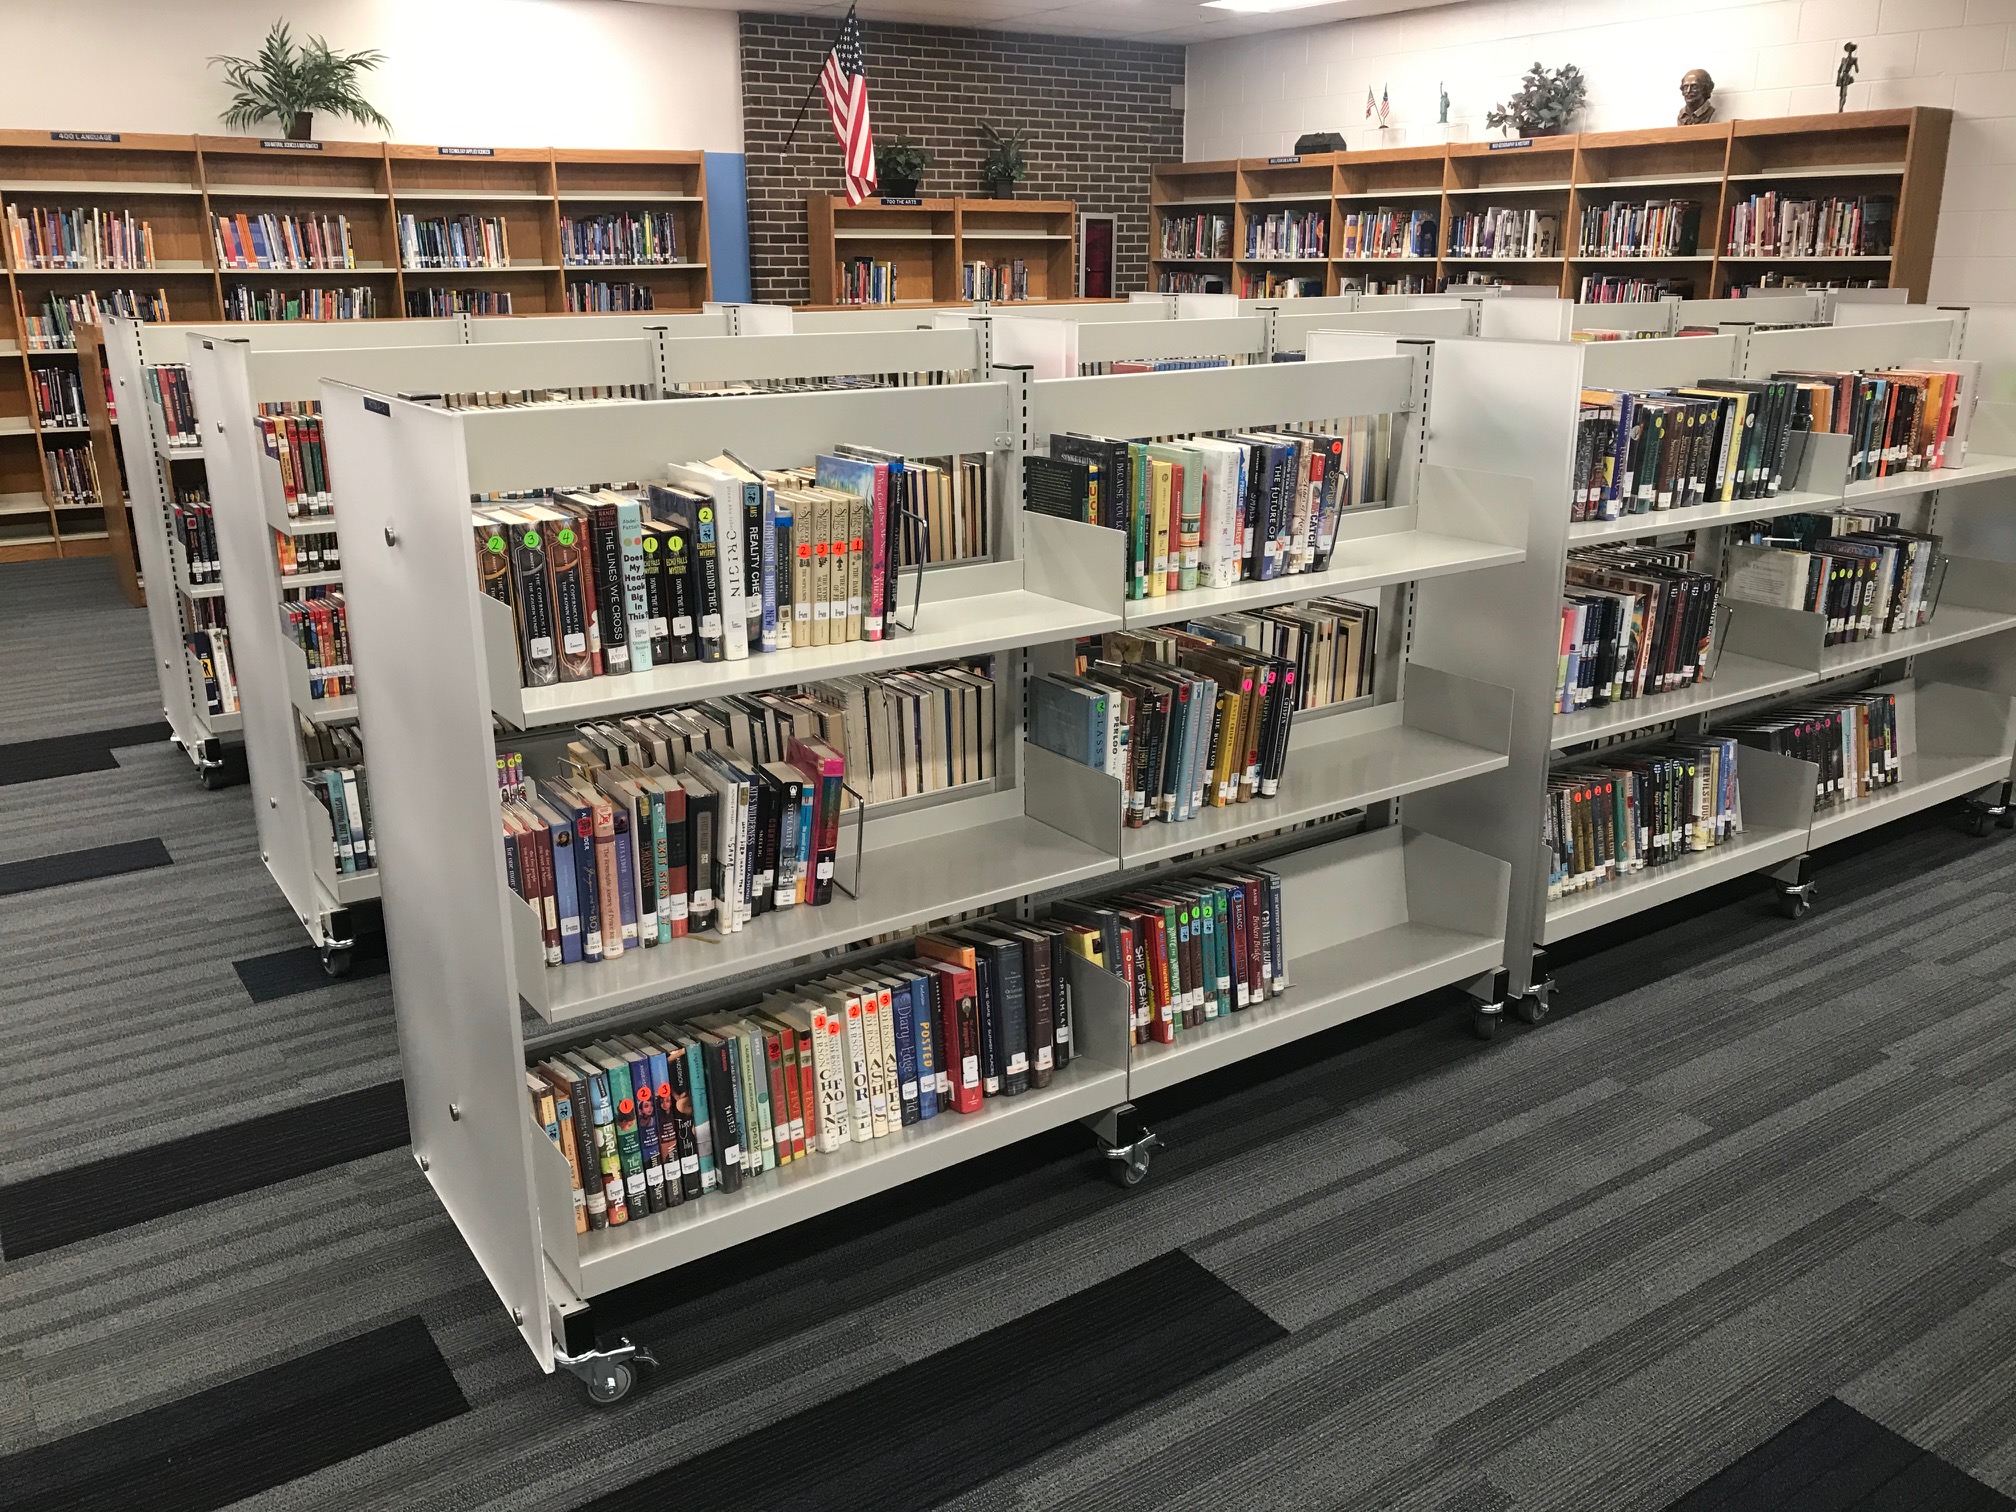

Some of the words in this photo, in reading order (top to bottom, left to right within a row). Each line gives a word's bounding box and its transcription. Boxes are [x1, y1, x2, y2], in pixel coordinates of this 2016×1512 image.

[1326, 470, 1338, 504] Sophie
[702, 511, 708, 520] 2
[1089, 486, 1097, 526] UCH
[1269, 487, 1280, 524] FUTURE
[528, 534, 534, 544] 3
[562, 532, 570, 543] 4
[605, 530, 614, 551] THE
[1235, 516, 1244, 545] FOREVE
[1268, 526, 1276, 540] OF
[1308, 512, 1318, 548] CATCH
[492, 538, 499, 550] 2
[750, 526, 760, 569] REALITY
[764, 520, 774, 562] CONFUSION
[800, 546, 806, 555] 2
[818, 544, 824, 554] 3
[836, 543, 842, 552] 4
[854, 540, 861, 550] 1
[606, 553, 618, 582] LINES
[624, 554, 642, 562] Does
[630, 564, 640, 572] My
[666, 558, 676, 566] ECHO
[676, 557, 687, 565] FALLS
[726, 530, 740, 598] ORIGIN
[625, 574, 646, 582] Head
[669, 566, 686, 574] MYSTERY
[706, 559, 716, 589] BEHIND
[765, 565, 774, 573] IS
[610, 585, 620, 603] WE
[626, 583, 646, 592] Look
[631, 594, 644, 602] Big
[765, 576, 775, 606] NOTHING
[709, 592, 717, 608] THE
[1710, 594, 1719, 624] DISASTER
[612, 606, 622, 640] CROSS
[628, 611, 648, 620] This?
[766, 610, 774, 626] NEW
[1270, 674, 1274, 682] 2
[1281, 698, 1289, 724] CRISPIN
[1211, 734, 1219, 767] BUTTON
[1702, 767, 1710, 796] DEVILS
[786, 803, 794, 826] STEVE
[1701, 806, 1709, 821] DUS
[748, 805, 757, 846] WILDERNESS
[785, 827, 794, 848] ALTEN
[657, 839, 667, 865] EXIT
[641, 846, 654, 887] CROSSOVER
[1205, 908, 1210, 916] 2
[1262, 931, 1270, 947] THE
[1135, 946, 1144, 971] SHIP
[1251, 940, 1260, 961] Bridge
[883, 995, 889, 1004] 3
[1138, 974, 1150, 1009] BREAK
[852, 1007, 857, 1016] 2
[831, 1024, 836, 1033] 2
[896, 1006, 911, 1039] Diary
[920, 1022, 932, 1067] POSTED
[899, 1046, 915, 1074] Edge
[662, 1085, 668, 1094] 3
[870, 1059, 886, 1123] ASHS
[600, 1097, 610, 1116] ME
[725, 1105, 736, 1134] TWISTED
[603, 1124, 616, 1158] EARL
[750, 1121, 760, 1152] Speak
